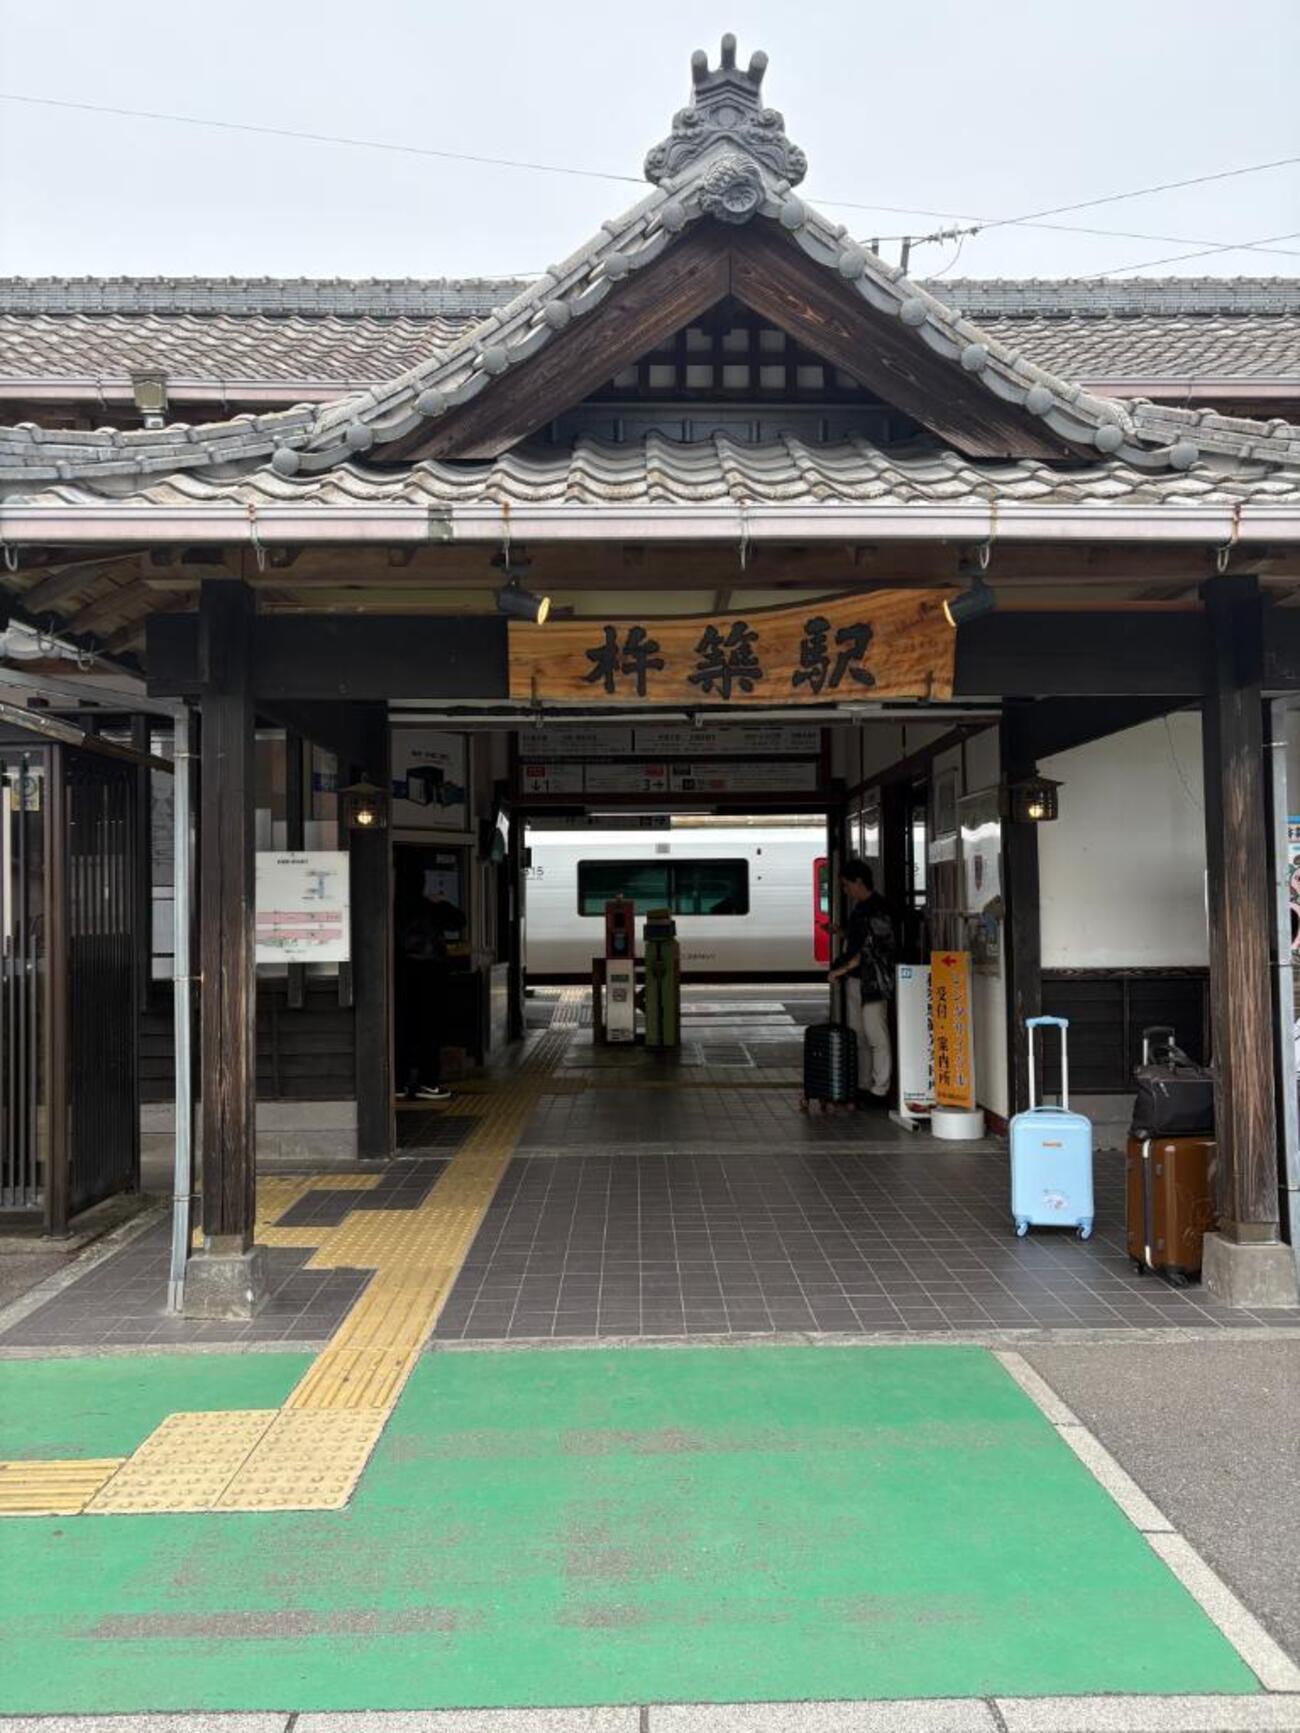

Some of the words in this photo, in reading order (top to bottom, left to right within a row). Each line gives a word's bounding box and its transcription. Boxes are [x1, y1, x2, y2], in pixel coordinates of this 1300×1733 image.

[581, 616, 876, 700] 杵築駅
[936, 985, 950, 1087] 受付・案内所
